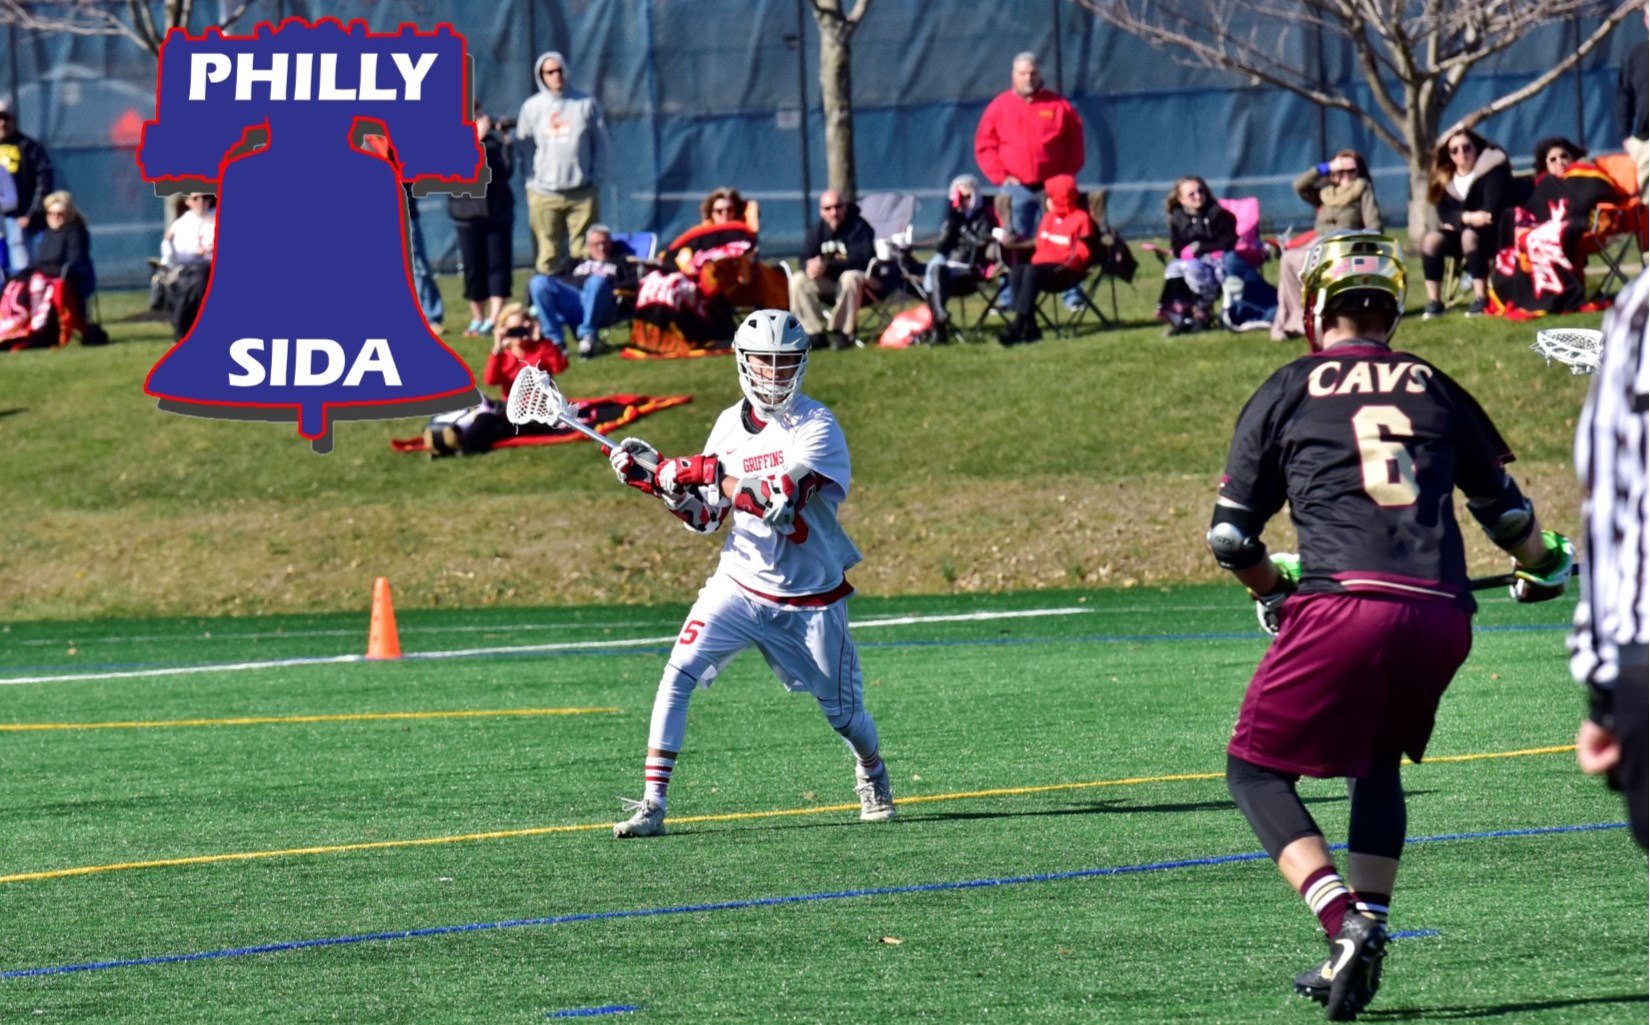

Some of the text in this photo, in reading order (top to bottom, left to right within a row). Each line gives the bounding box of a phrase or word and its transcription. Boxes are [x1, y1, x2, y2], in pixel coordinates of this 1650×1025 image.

[1308, 360, 1433, 397] CAVS
[743, 450, 785, 474] GRIFFINS
[1352, 404, 1421, 508] 6
[679, 620, 705, 645] 5
